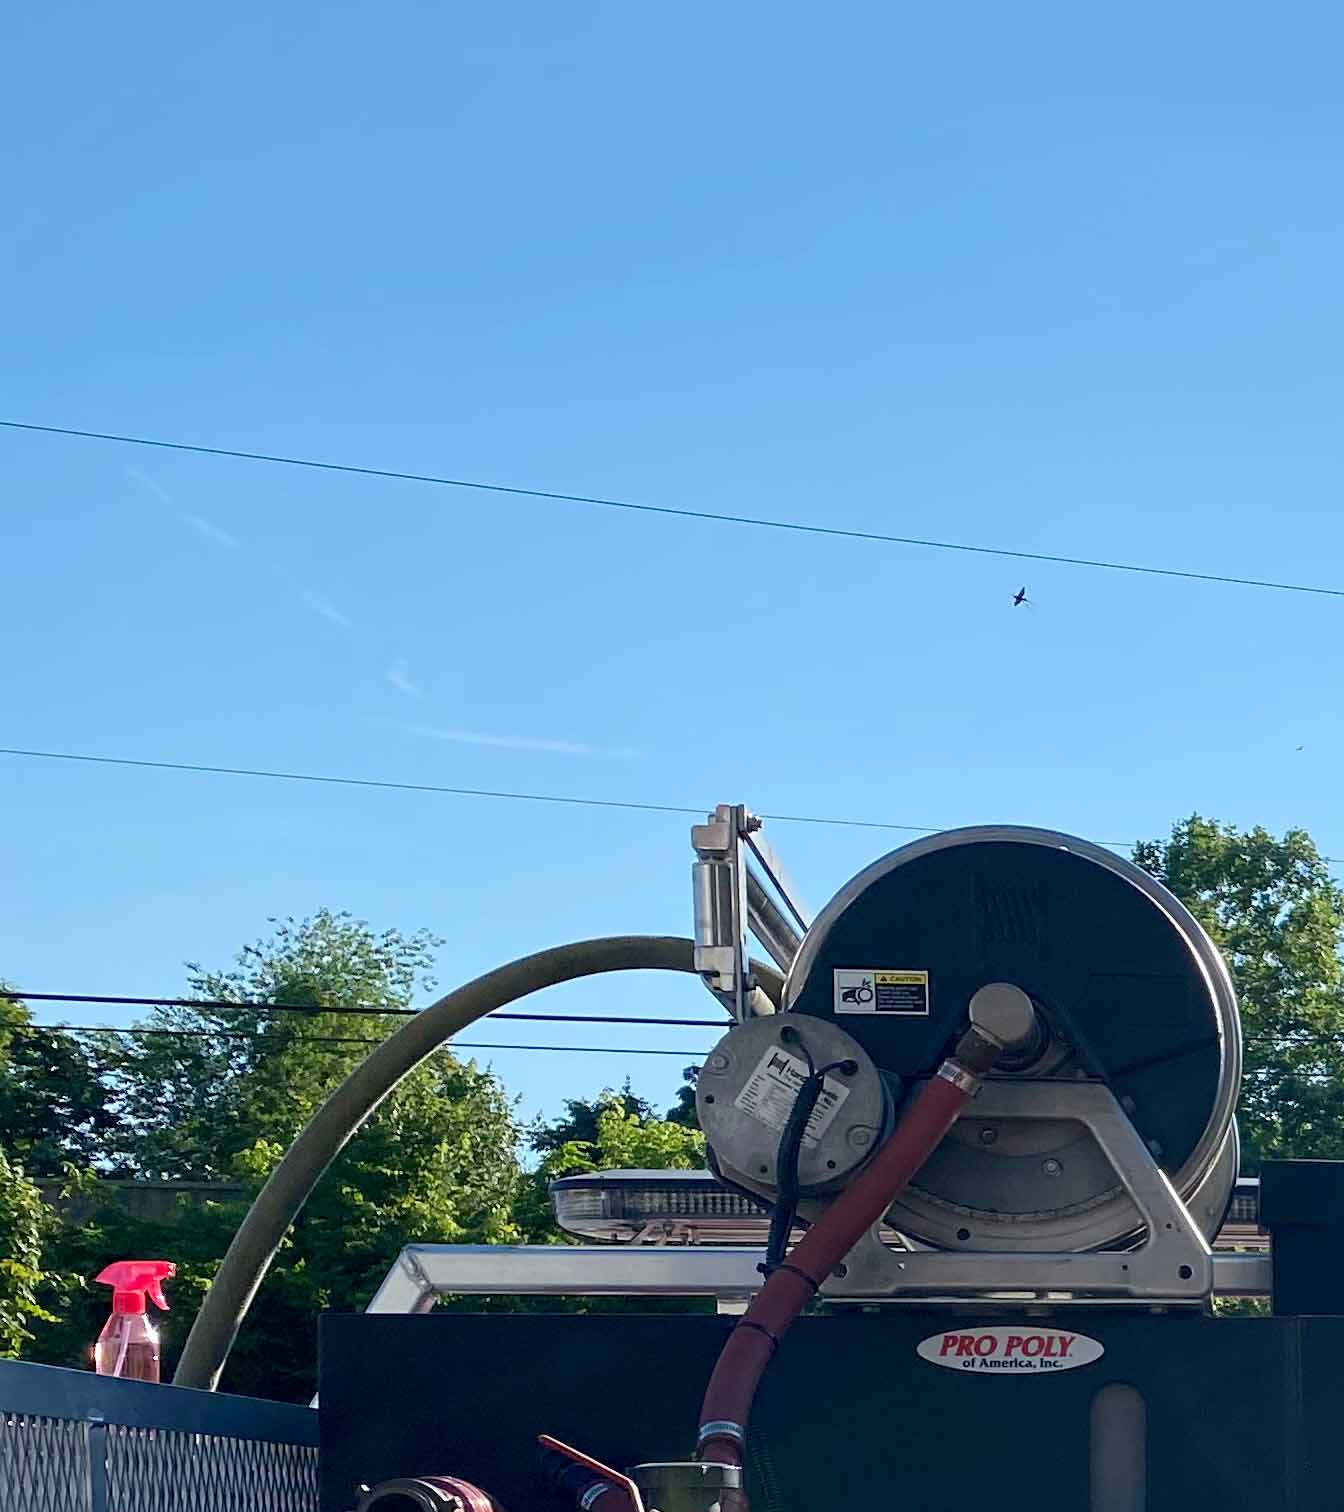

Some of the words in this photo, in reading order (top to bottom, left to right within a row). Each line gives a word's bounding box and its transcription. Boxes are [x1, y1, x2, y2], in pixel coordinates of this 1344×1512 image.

[939, 1335, 998, 1357] PRO
[1004, 1335, 1076, 1357] POLY
[962, 1358, 975, 1369] of
[979, 1358, 1037, 1369] America,
[1039, 1358, 1063, 1369] Inc.
